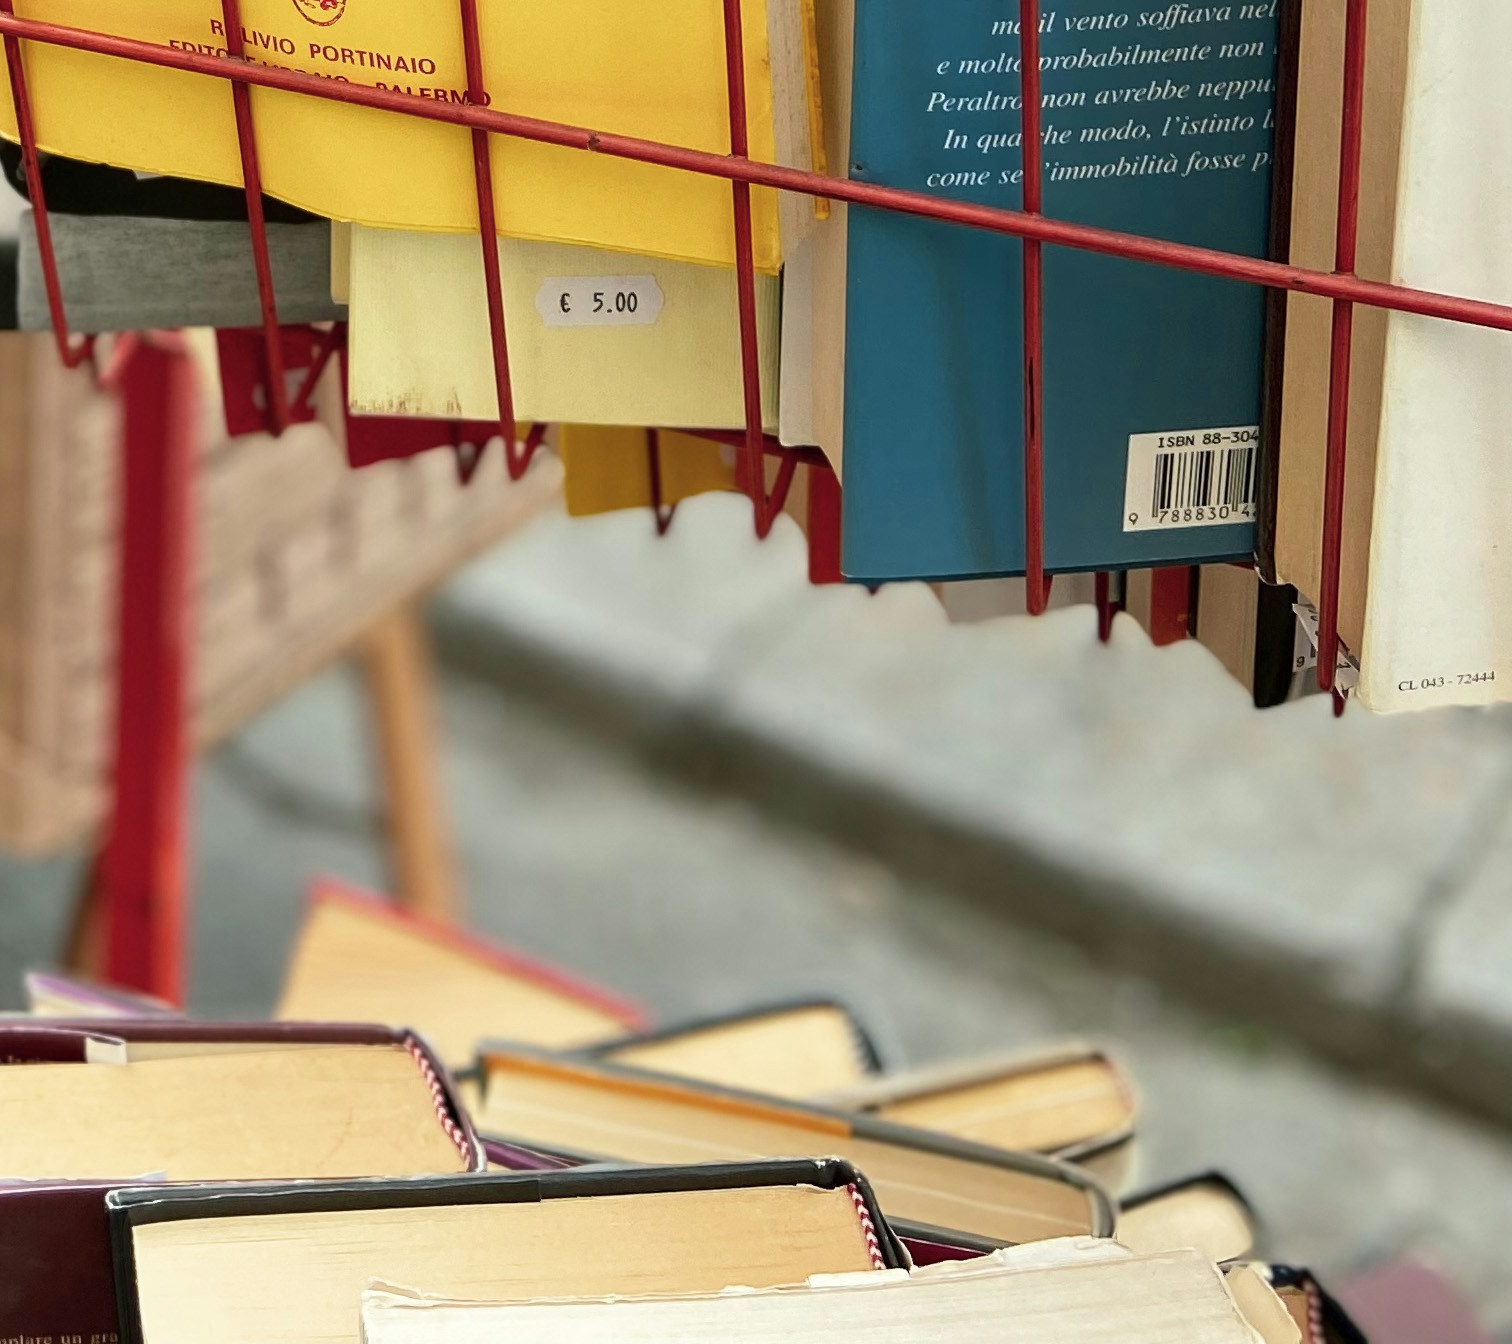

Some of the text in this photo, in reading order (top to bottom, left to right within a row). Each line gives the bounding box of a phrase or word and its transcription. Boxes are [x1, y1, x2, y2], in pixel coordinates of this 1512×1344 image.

[1038, 3, 1232, 33] il vento soffiava
[309, 42, 437, 75] PORTINAIO
[937, 59, 951, 75] e
[1038, 43, 1212, 72] probabilmente
[1219, 40, 1265, 59] non
[926, 79, 1190, 112] Peraltro non avrebbe
[944, 129, 968, 150] In
[1079, 119, 1151, 143] modo,
[926, 169, 991, 188] come
[998, 169, 1024, 185] se
[1181, 150, 1246, 178] fosse
[592, 291, 638, 313] 5.00
[1158, 435, 1195, 449] ISBN
[1398, 676, 1419, 692] CL
[1420, 675, 1445, 689] 043
